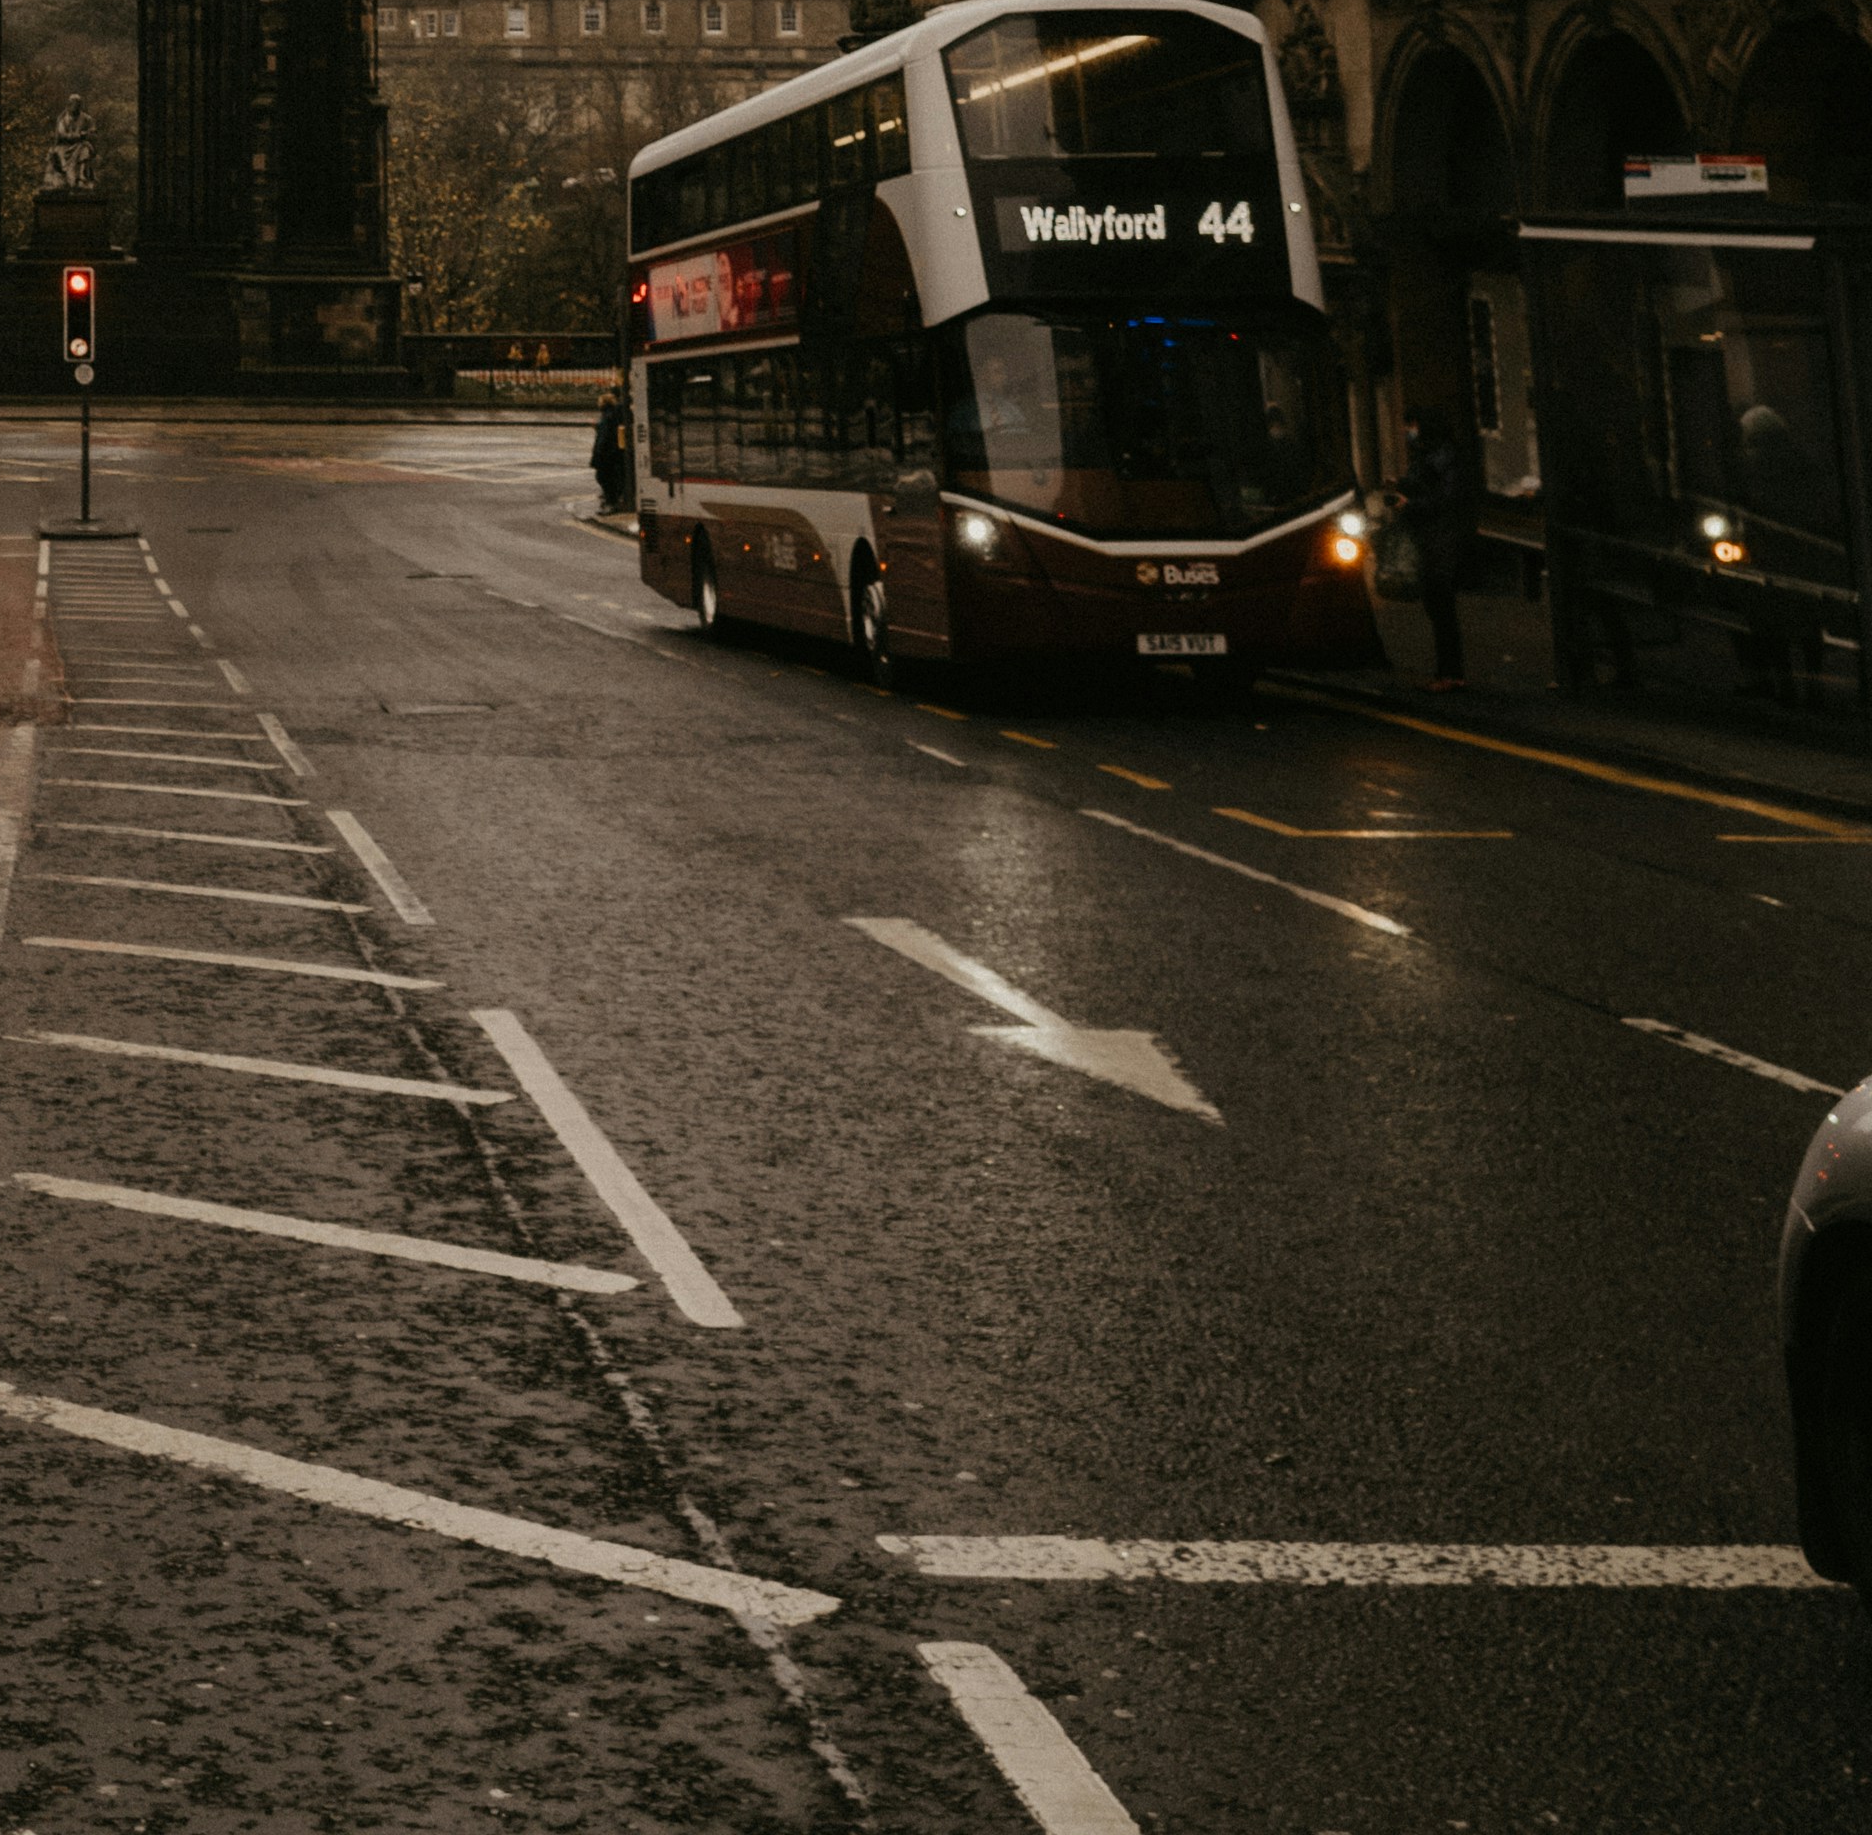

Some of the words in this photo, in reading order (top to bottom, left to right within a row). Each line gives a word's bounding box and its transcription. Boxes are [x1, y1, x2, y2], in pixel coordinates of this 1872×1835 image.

[1019, 204, 1167, 246] Wallyford
[1197, 200, 1256, 244] 44
[1162, 563, 1221, 585] Buses
